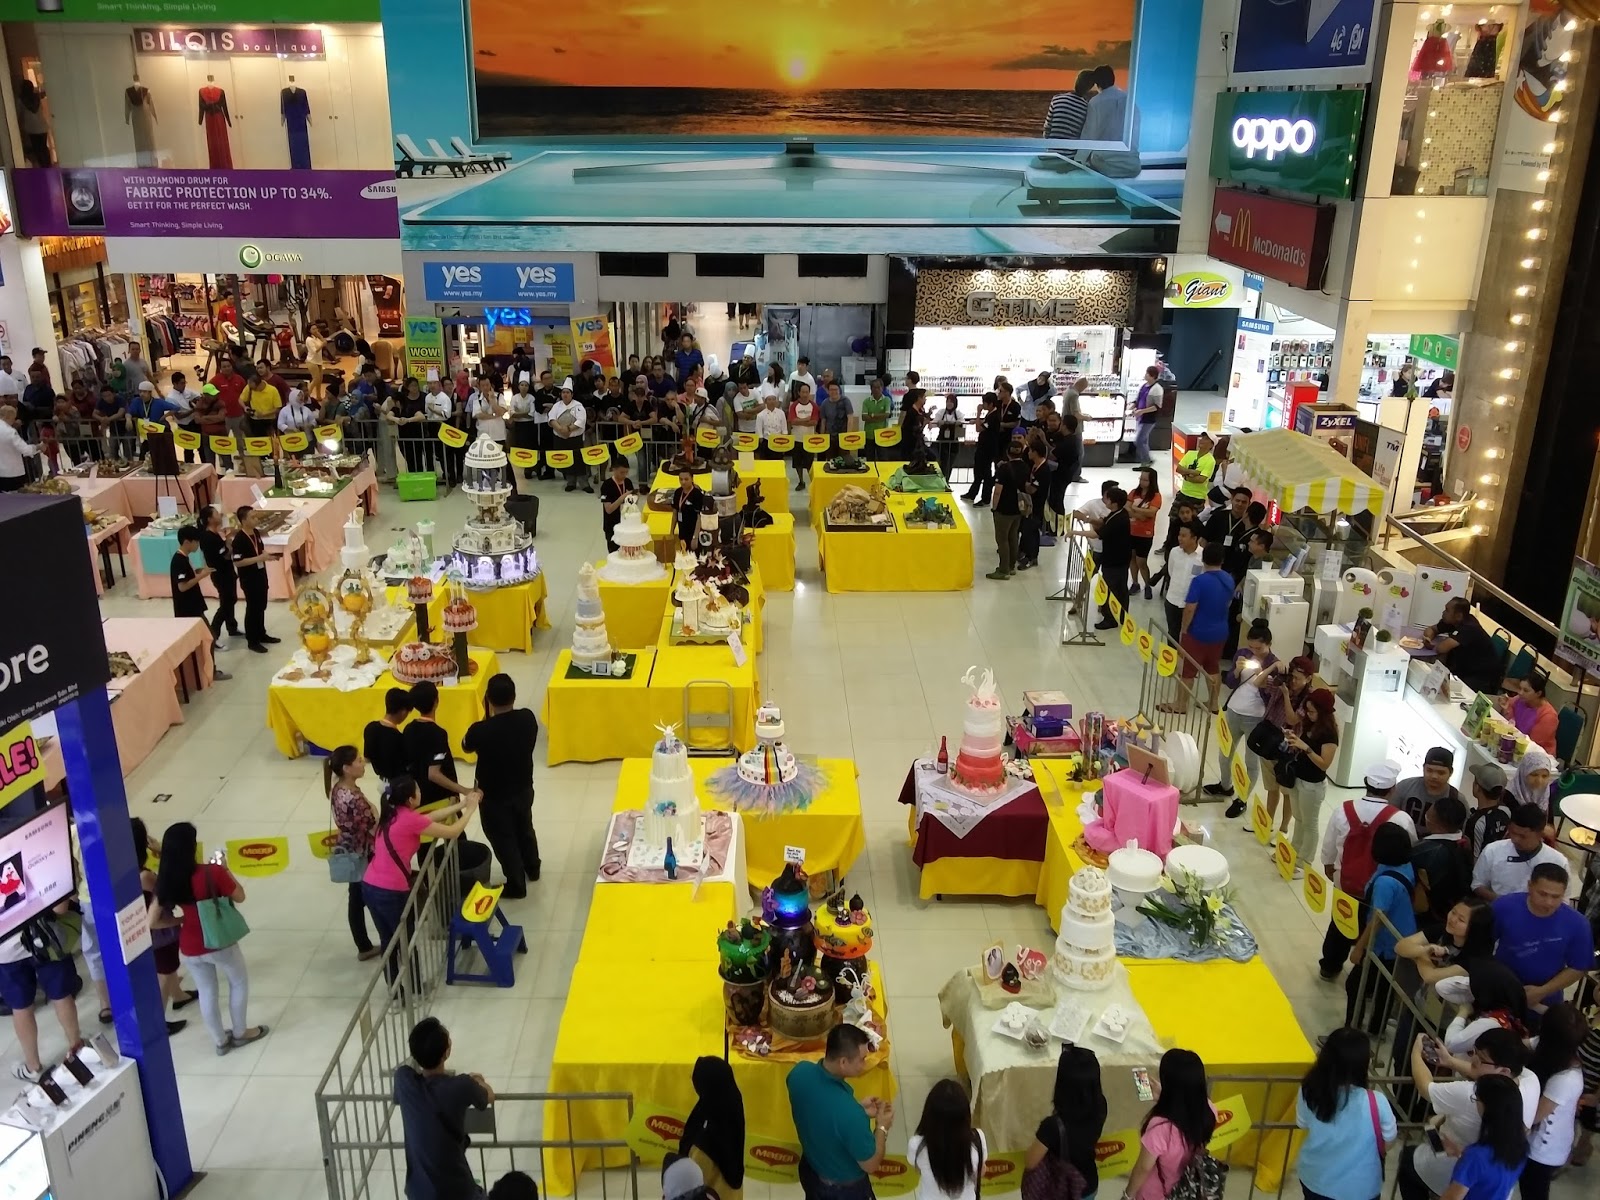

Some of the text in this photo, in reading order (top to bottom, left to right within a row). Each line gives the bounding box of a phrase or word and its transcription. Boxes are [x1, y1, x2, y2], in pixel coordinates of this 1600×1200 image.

[141, 31, 236, 51] BILQIS
[1232, 117, 1316, 160] oppo
[123, 176, 229, 185] WITH DIAMOND DRUM FOR
[126, 186, 333, 199] FABRIC PROTECTION UP TO 34%.
[127, 201, 143, 210] GET
[145, 202, 154, 210] IT
[156, 202, 172, 210] FOR
[173, 202, 190, 210] THE
[191, 202, 226, 210] PERFECT
[130, 221, 151, 229] Smart
[181, 221, 203, 230] Simple
[265, 253, 303, 262] OGAWA
[1252, 236, 1306, 268] McDonald's
[441, 265, 557, 289] yes yes
[1185, 278, 1229, 304] Giant
[484, 307, 532, 333] yes
[576, 320, 603, 336] yes
[1241, 320, 1270, 332] SAMSUNG
[408, 321, 438, 337] yes
[409, 347, 441, 357] WOW!
[1320, 417, 1352, 427] ZyXEL
[1386, 441, 1399, 452] TM
[0, 736, 38, 790] LE!
[25, 821, 53, 840] SAMSUNG
[651, 1119, 686, 1137] Magg
